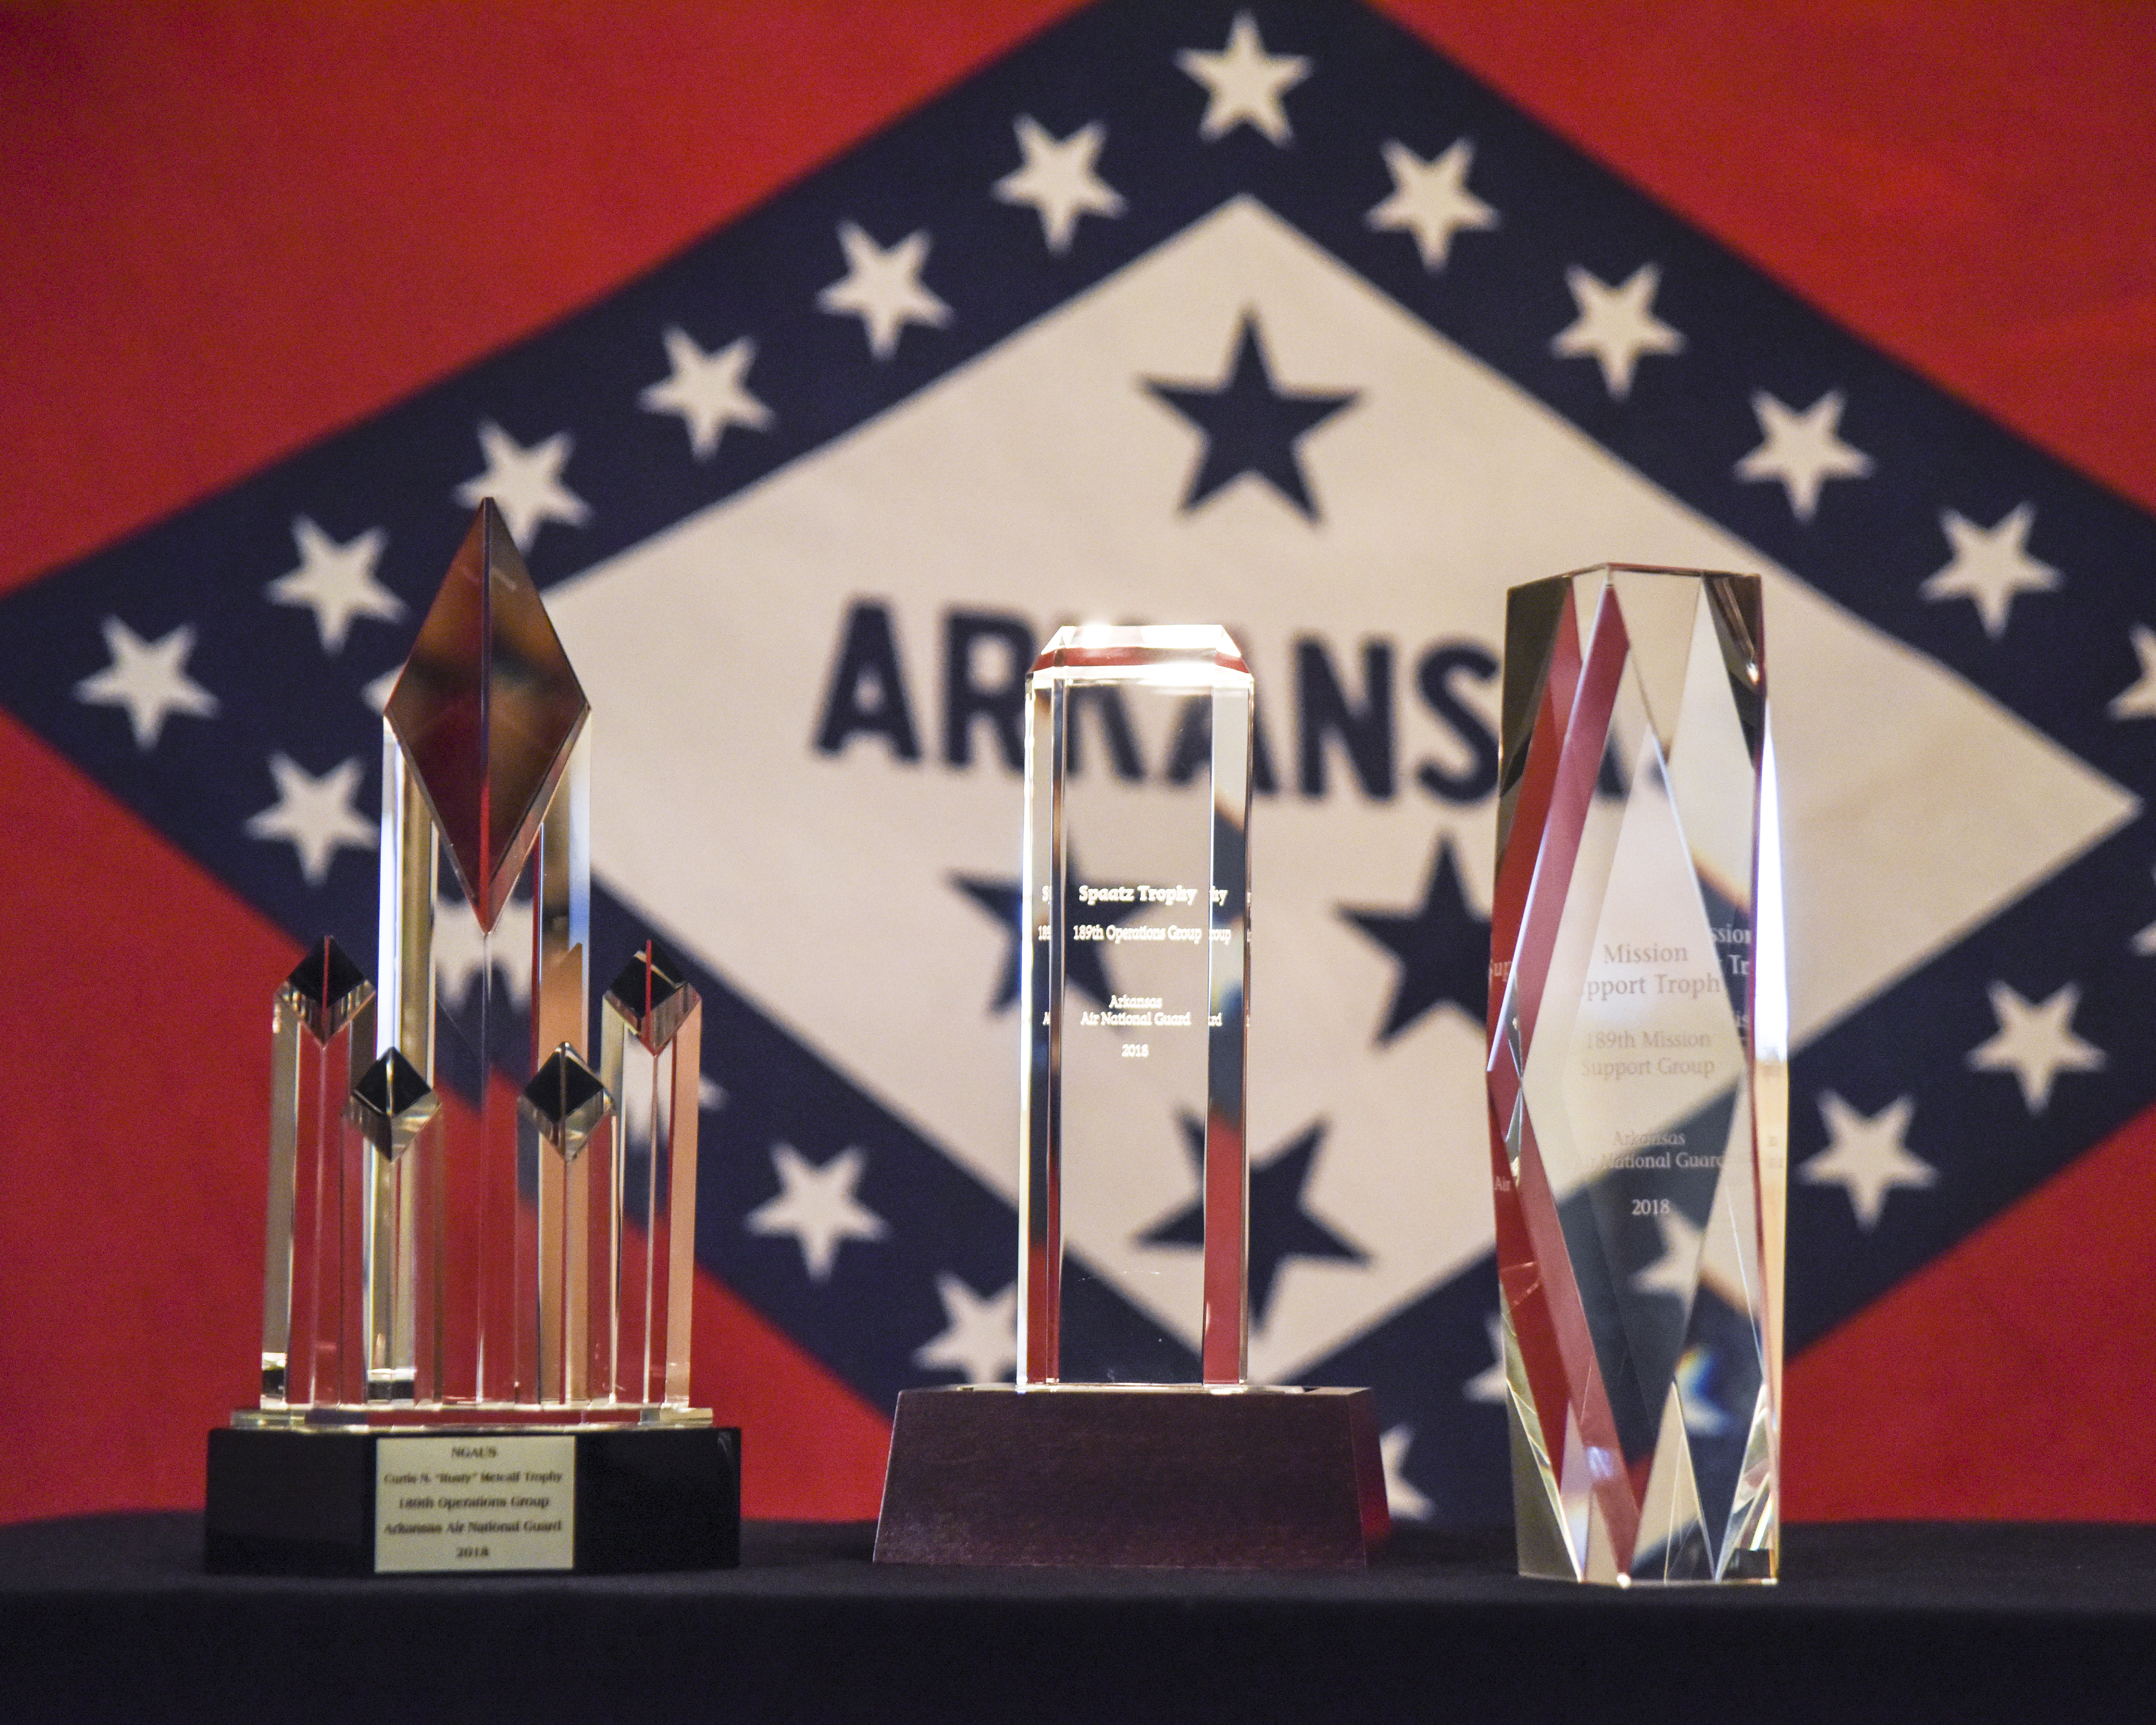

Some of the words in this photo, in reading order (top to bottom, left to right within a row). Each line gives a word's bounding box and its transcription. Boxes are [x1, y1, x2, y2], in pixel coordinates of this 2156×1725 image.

[1079, 885, 1135, 905] Spaatz
[1137, 885, 1198, 906] Trophy
[1073, 924, 1105, 941] 189th
[1105, 924, 1166, 945] Operations
[1167, 924, 1202, 945] Group
[1603, 942, 1688, 963] Mission
[1586, 976, 1646, 1001] pport
[1654, 972, 1720, 1000] Troph
[1108, 994, 1163, 1009] Arkansas
[1080, 1011, 1100, 1026] Air
[1100, 1011, 1152, 1026] National
[1154, 1011, 1192, 1026] Guard
[1587, 1030, 1636, 1049] 189th
[1642, 1030, 1712, 1048] Mission
[1581, 1058, 1652, 1081] Support
[1656, 1057, 1715, 1079] Group
[1613, 1129, 1686, 1146] Arkansas
[1600, 1151, 1671, 1169] National
[1631, 1198, 1671, 1216] 2018
[525, 1470, 563, 1485] Trophy
[438, 1495, 507, 1511] Operations
[510, 1495, 550, 1510] Group
[384, 1522, 442, 1535] Arkansas
[447, 1520, 465, 1534] Air
[468, 1520, 519, 1533] National
[523, 1519, 562, 1532] Guard
[455, 1546, 490, 1559] 2018
